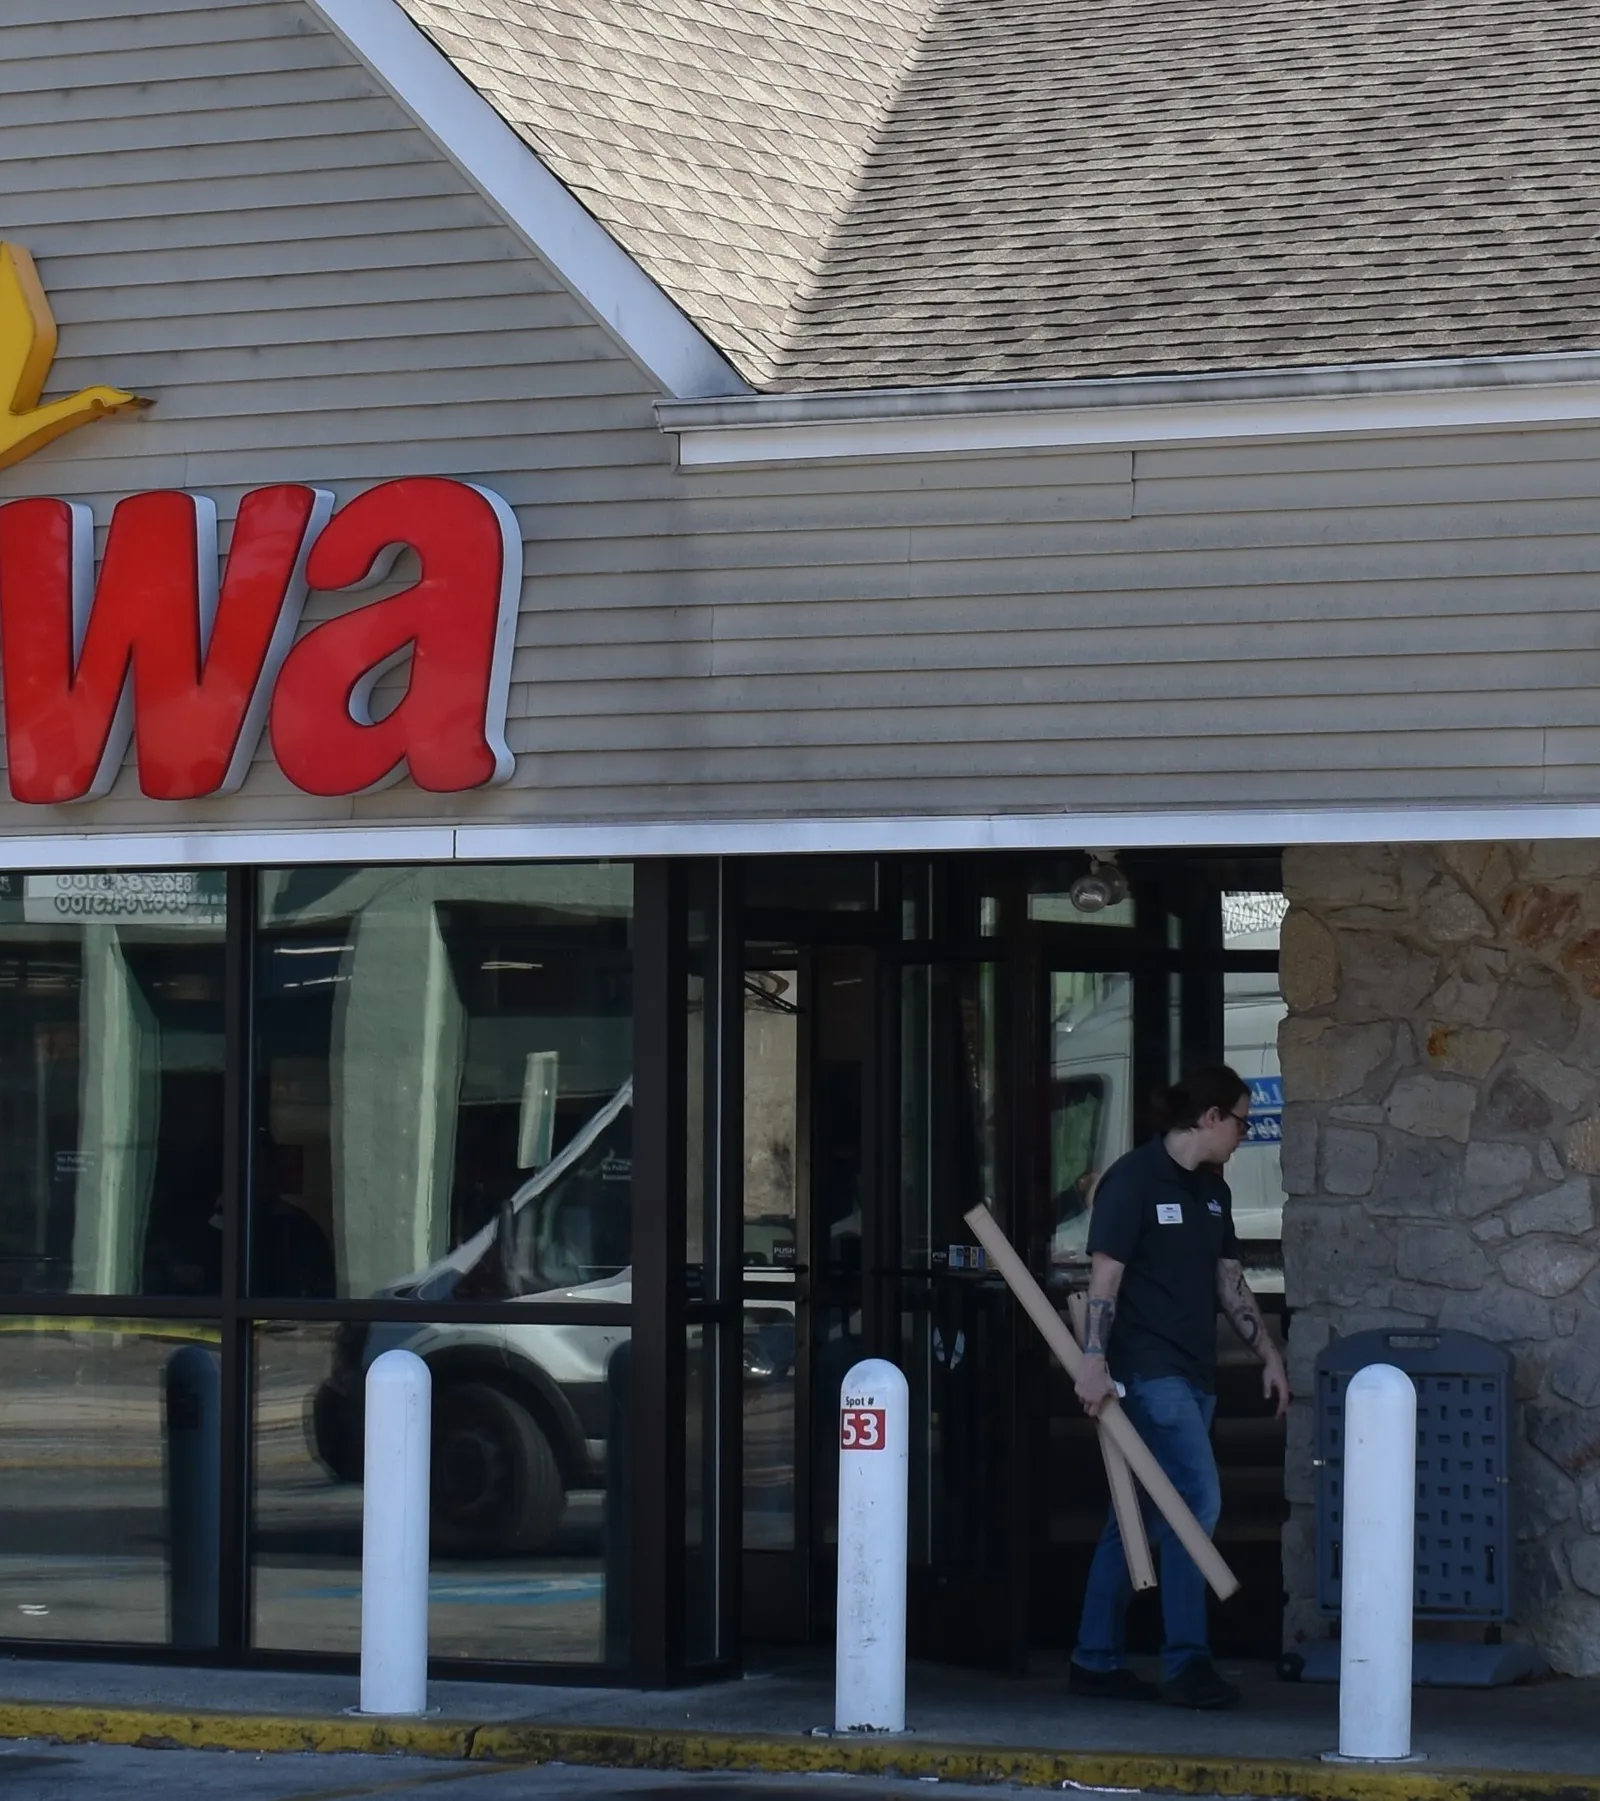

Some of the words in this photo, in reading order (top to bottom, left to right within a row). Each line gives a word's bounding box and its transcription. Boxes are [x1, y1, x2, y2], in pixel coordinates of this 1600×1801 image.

[845, 1396, 865, 1408] Spot
[868, 1397, 875, 1406] #
[842, 1412, 879, 1446] 53
